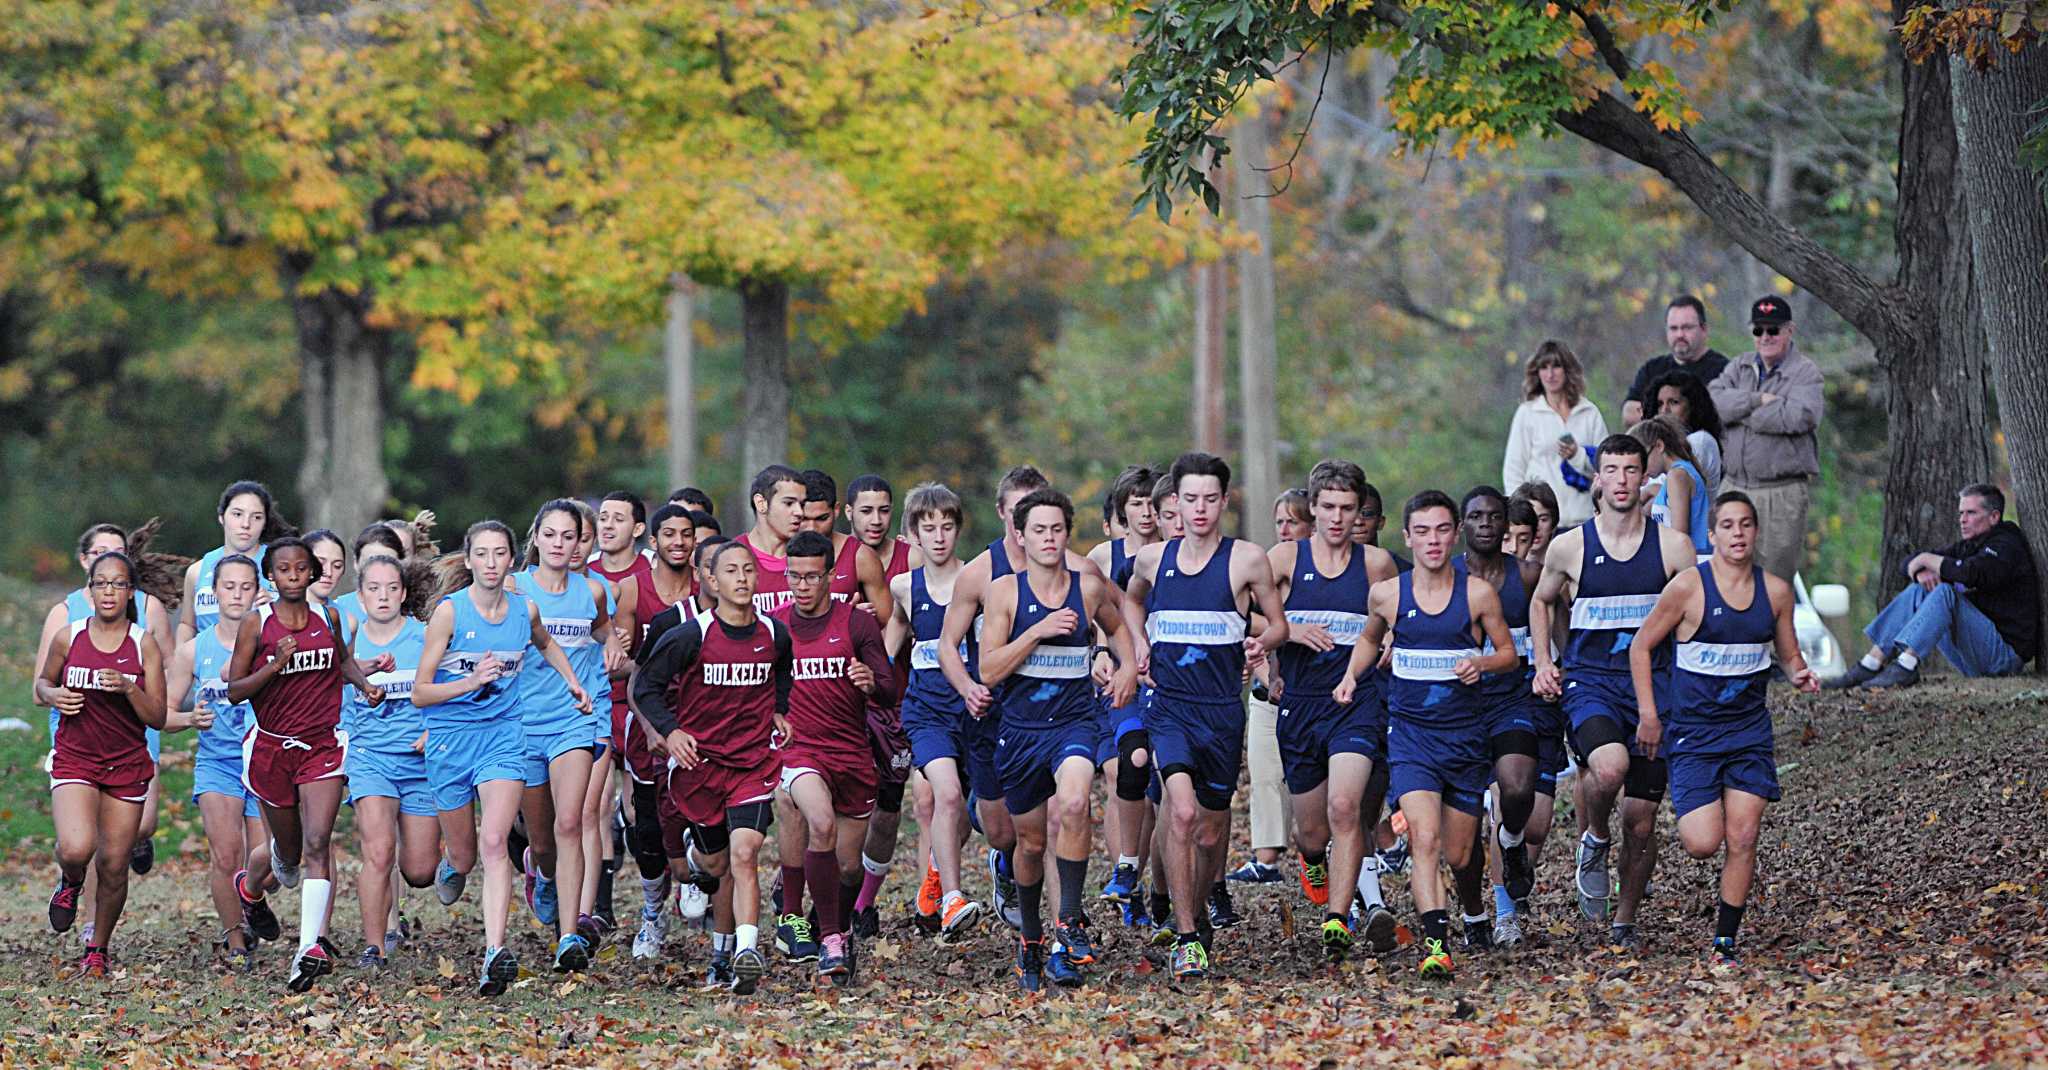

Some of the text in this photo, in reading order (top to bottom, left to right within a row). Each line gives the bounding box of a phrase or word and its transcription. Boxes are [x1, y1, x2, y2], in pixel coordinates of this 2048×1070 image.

[1157, 621, 1228, 636] MIDDLETOWN
[266, 647, 334, 675] LKELEY
[790, 657, 845, 680] LKELEY
[1024, 655, 1085, 668] IDDLETOWN
[1397, 654, 1463, 669] MIDDLETO
[703, 663, 772, 686] BULKELEY
